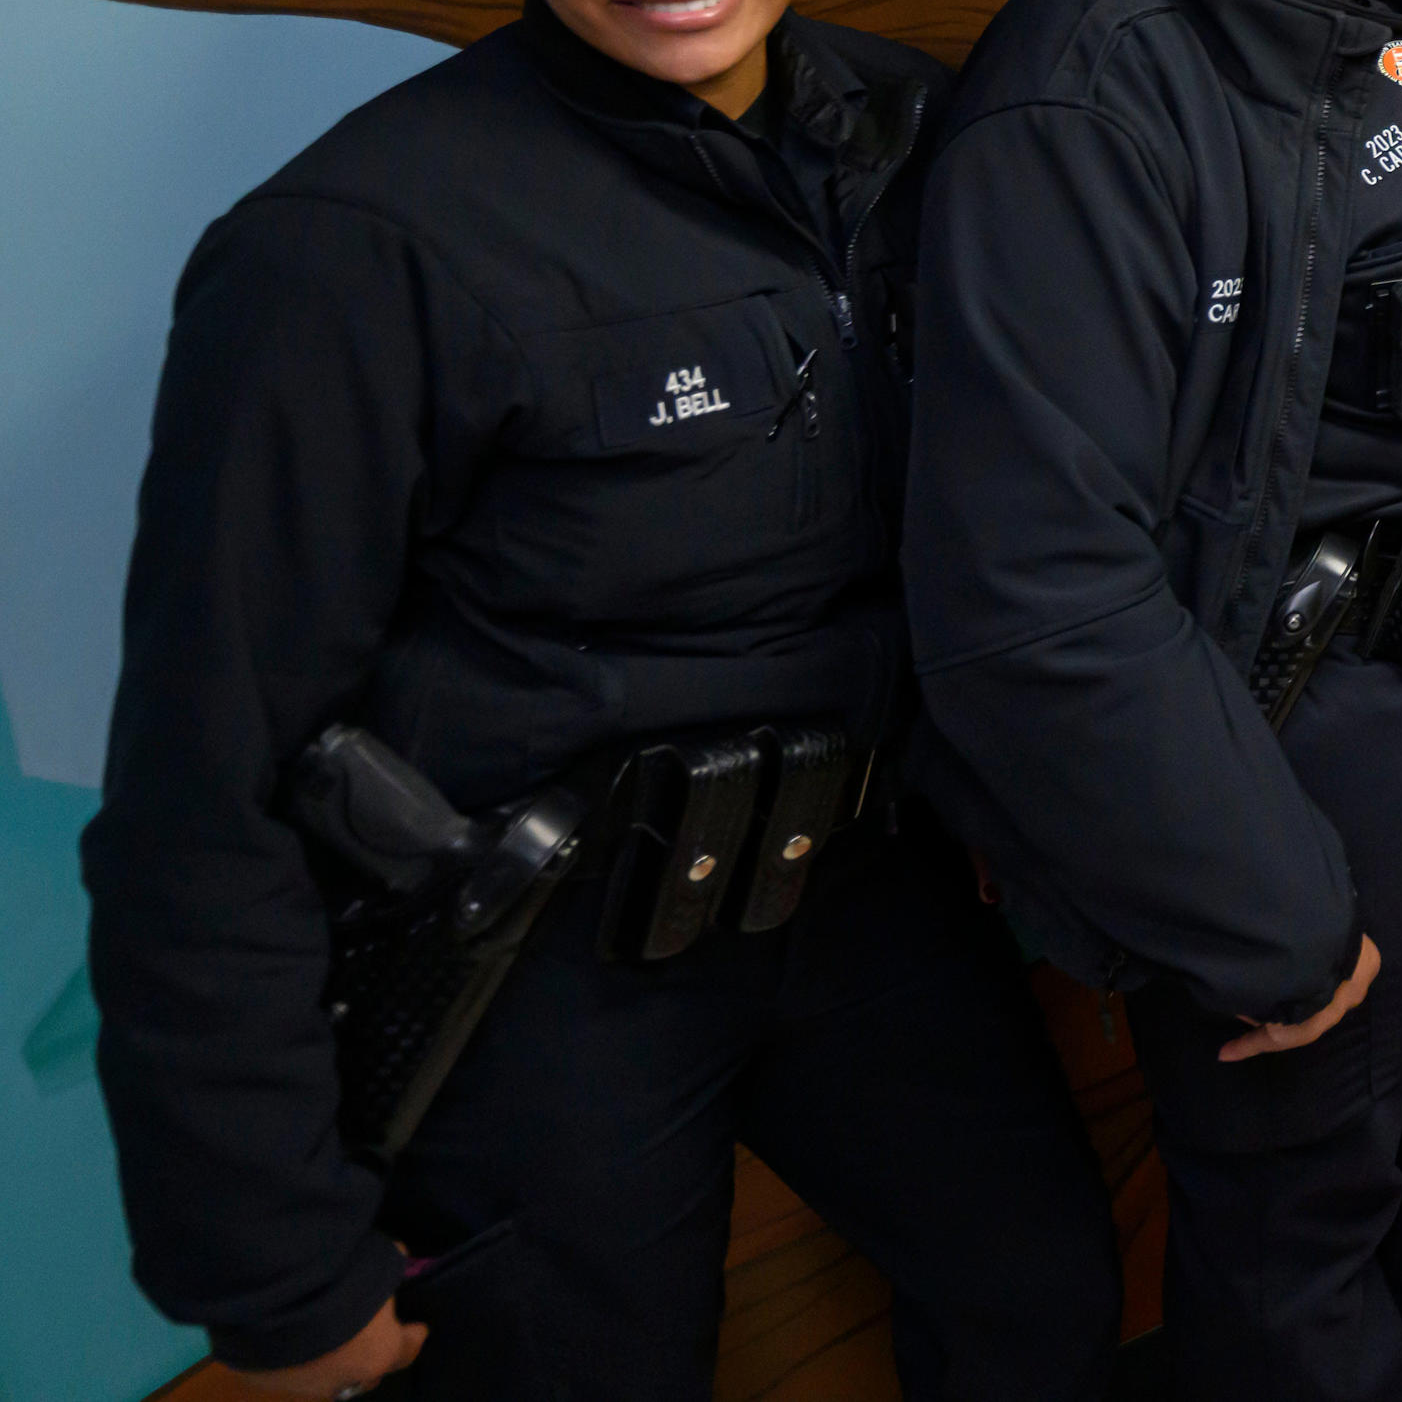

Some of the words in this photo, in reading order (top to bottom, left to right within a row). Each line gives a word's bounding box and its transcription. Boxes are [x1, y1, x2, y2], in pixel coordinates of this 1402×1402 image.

[1360, 168, 1384, 186] C.
[1211, 277, 1245, 299] 202
[664, 365, 707, 395] 434
[648, 400, 675, 427] J.
[675, 387, 732, 421] BELL
